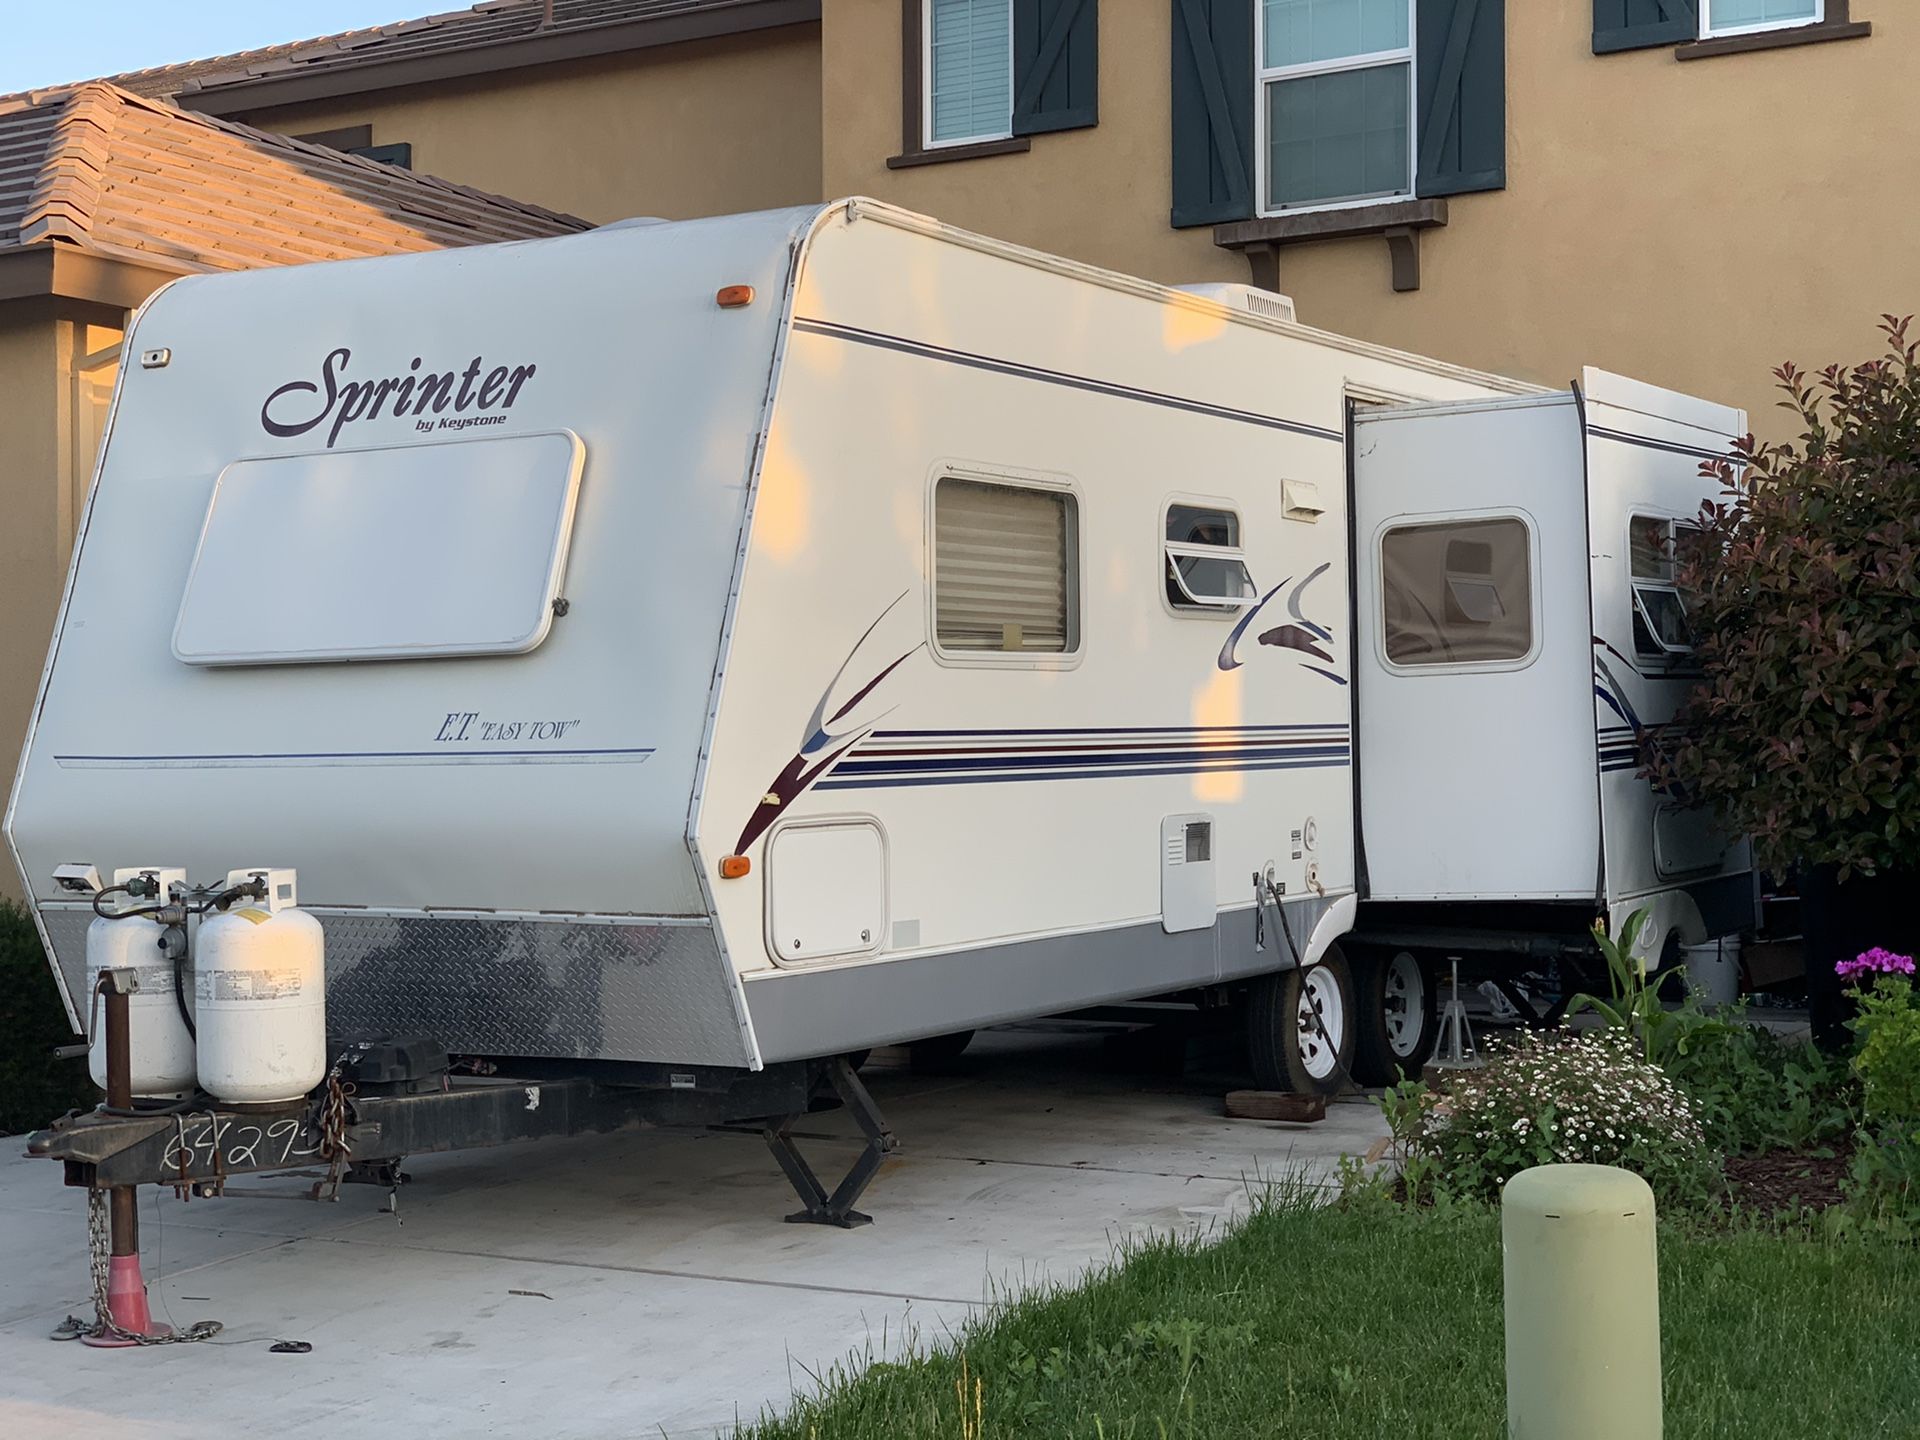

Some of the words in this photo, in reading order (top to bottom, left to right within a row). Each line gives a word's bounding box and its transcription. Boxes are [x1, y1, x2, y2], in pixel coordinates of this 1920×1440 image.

[261, 348, 537, 448] Sprinter
[415, 419, 435, 433] by
[438, 414, 507, 431] Keystone
